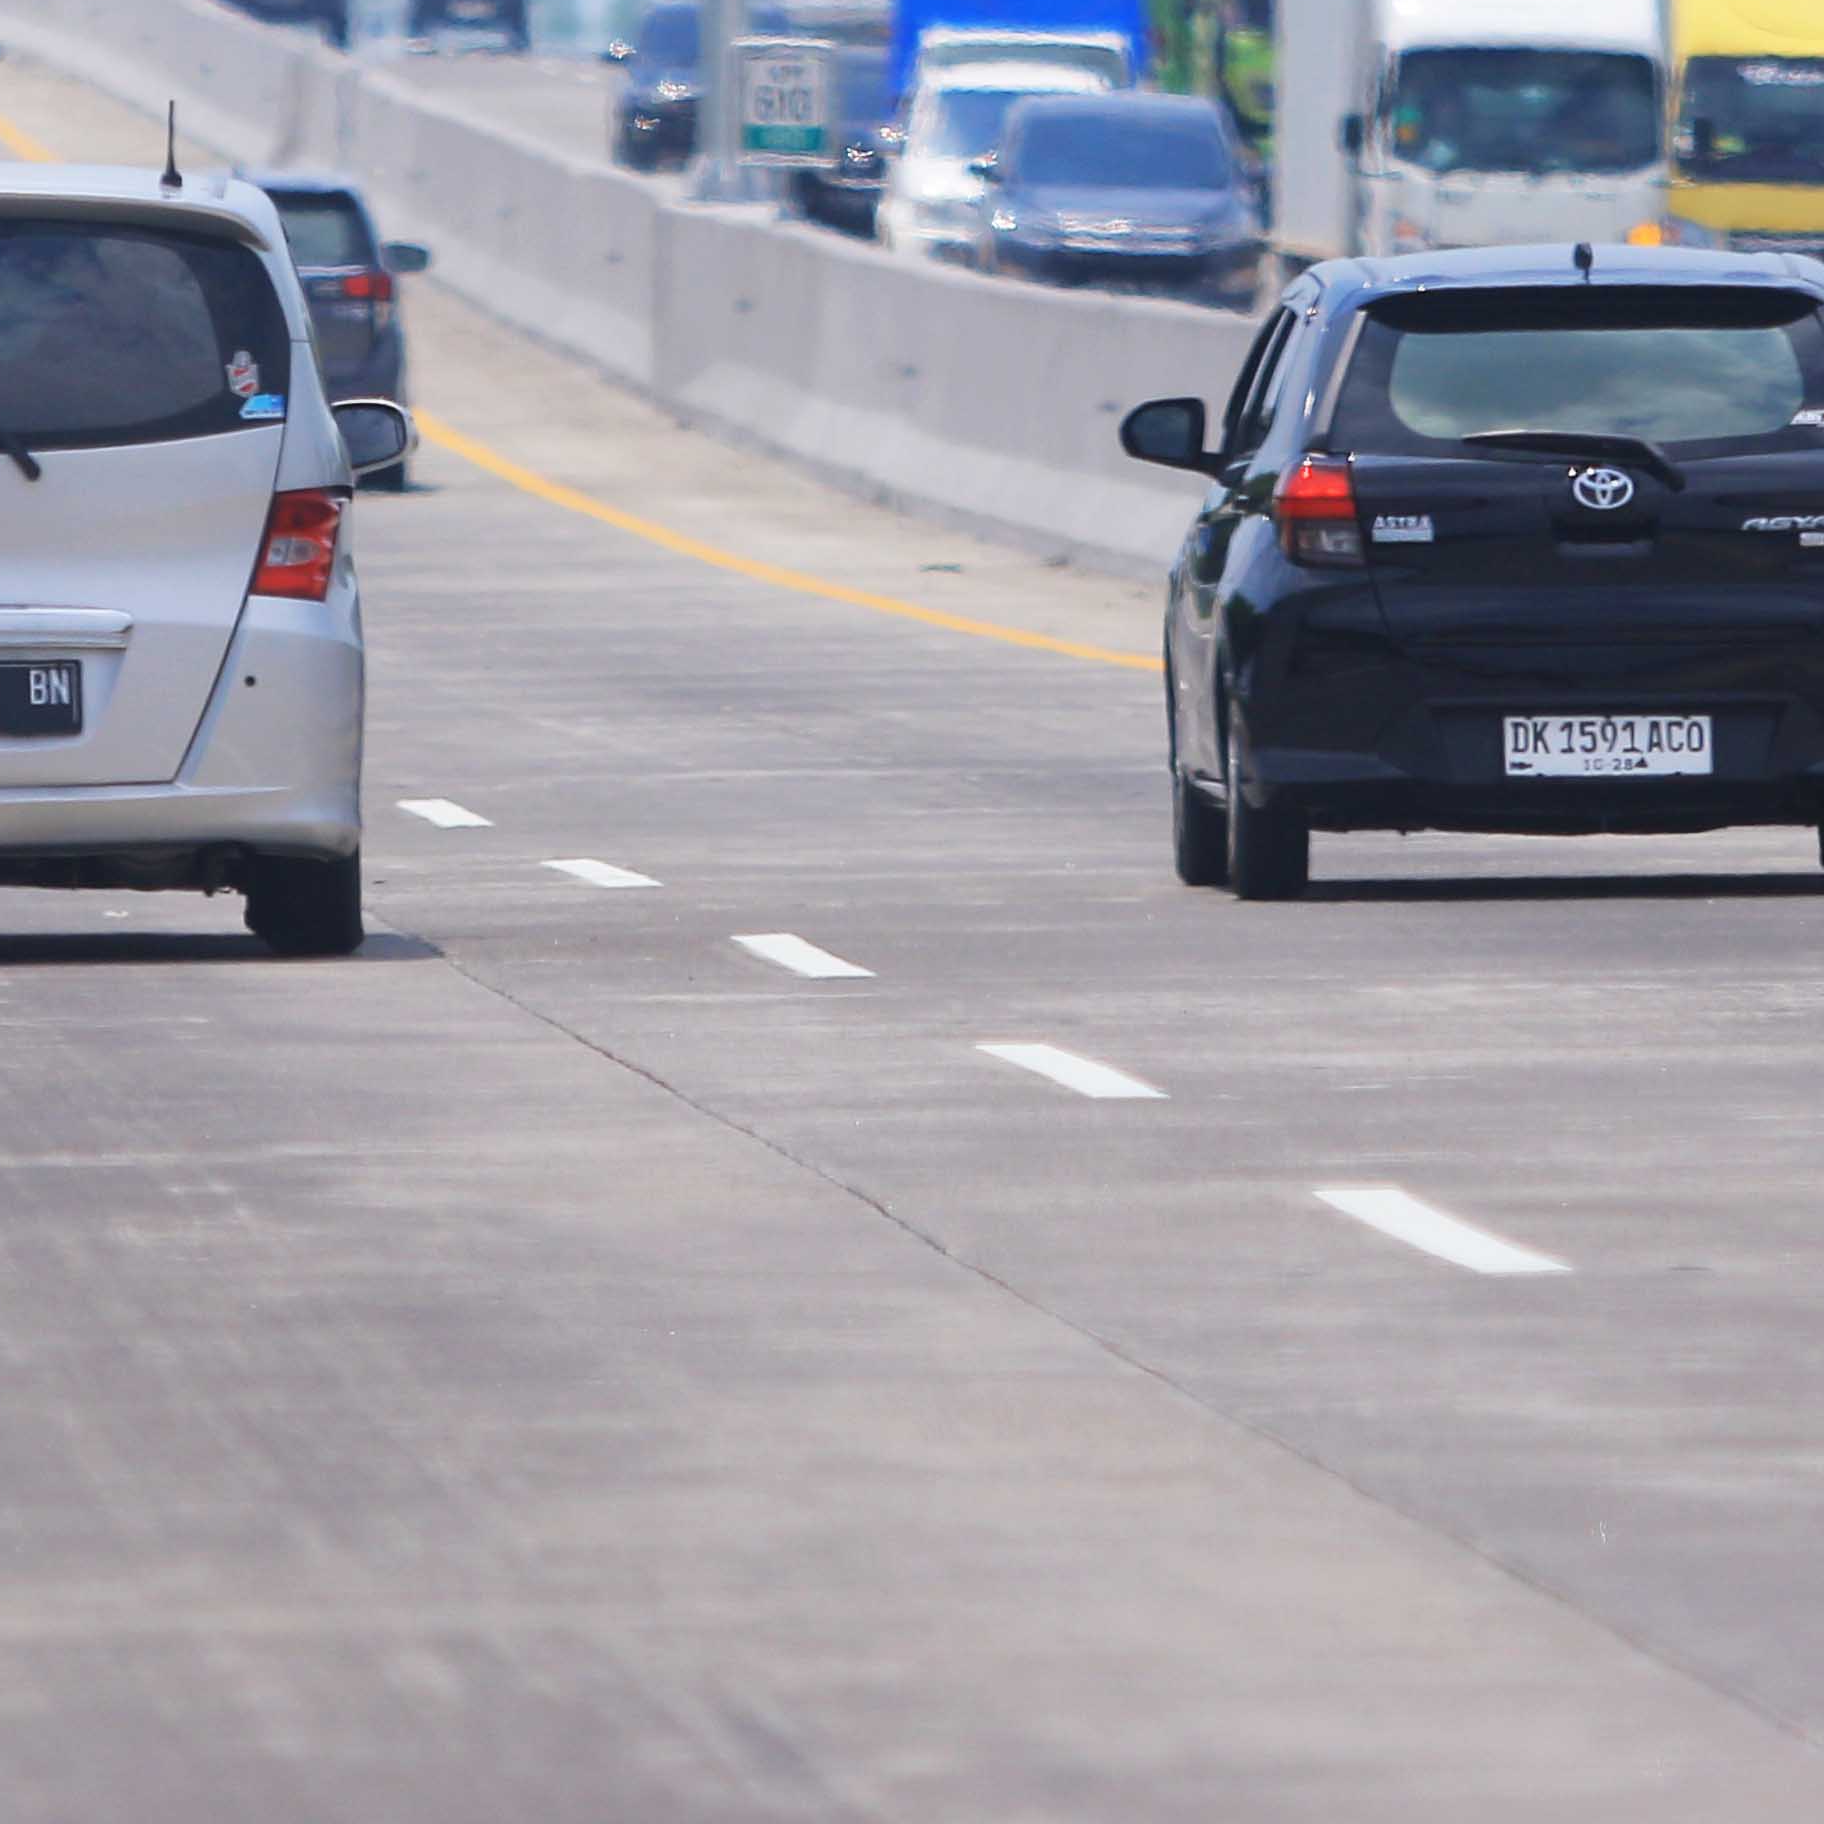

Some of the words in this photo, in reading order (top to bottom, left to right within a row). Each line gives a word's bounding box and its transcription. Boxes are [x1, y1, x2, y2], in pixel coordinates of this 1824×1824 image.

[29, 669, 70, 705] BN
[1510, 721, 1550, 754] DK
[1559, 720, 1642, 754] 1591
